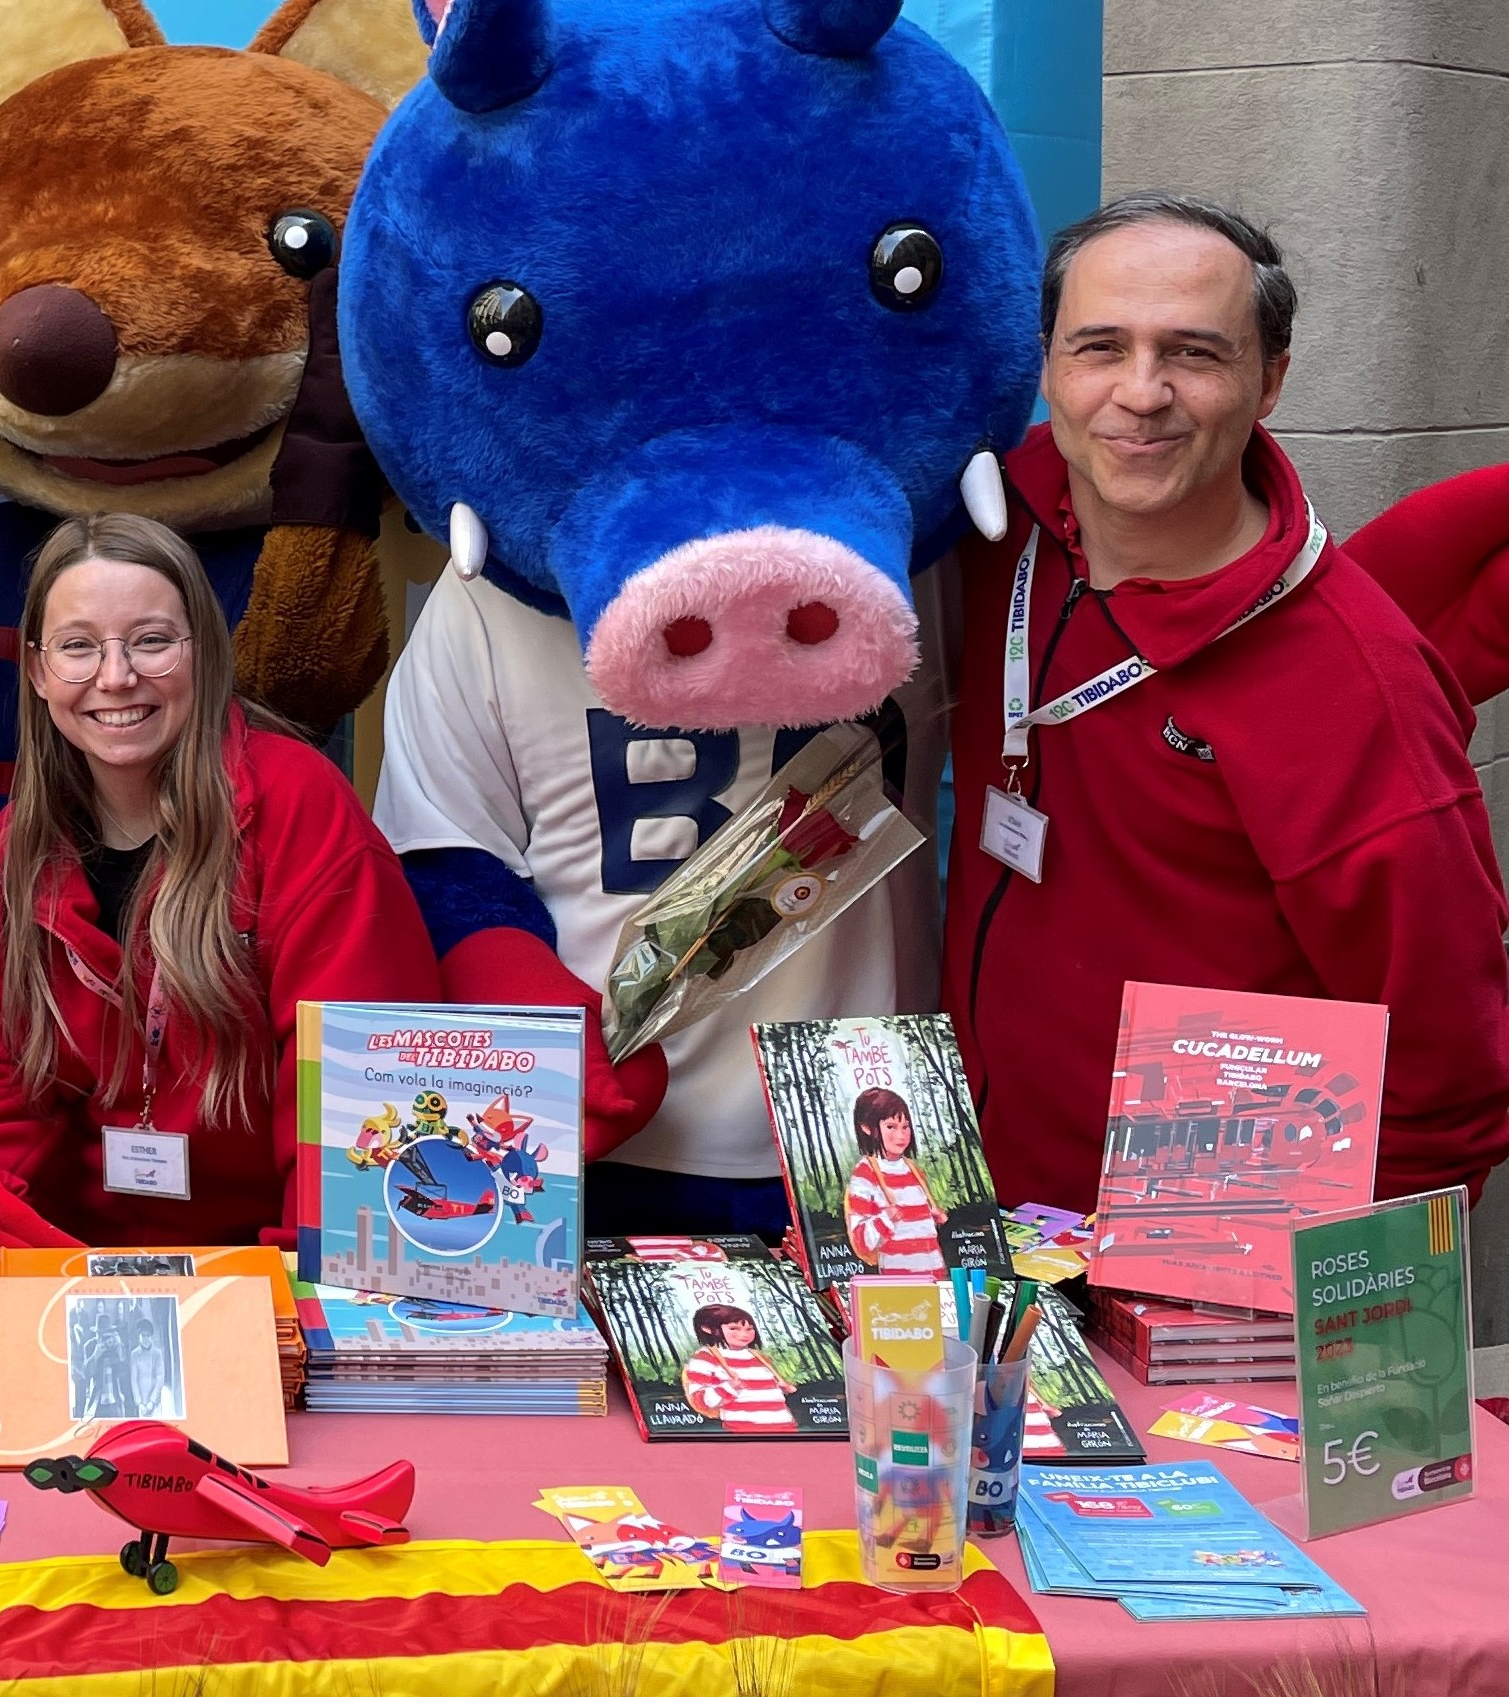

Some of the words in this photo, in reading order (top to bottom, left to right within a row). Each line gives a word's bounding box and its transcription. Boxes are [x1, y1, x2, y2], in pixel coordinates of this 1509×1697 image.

[1011, 552, 1032, 632] TIBIDABO!
[1162, 726, 1188, 751] BCN
[367, 1034, 393, 1050] LES
[393, 1030, 492, 1049] MASCOTES
[415, 1048, 535, 1073] TIBIDABO
[1172, 1039, 1322, 1068] CUCADELLUM
[1220, 1063, 1267, 1074] FUNICULAR
[364, 1067, 394, 1082] Com
[398, 1073, 427, 1087] vola
[431, 1075, 444, 1089] la
[448, 1077, 533, 1098] imaginació?
[501, 1186, 519, 1199] BO
[820, 1243, 852, 1260] ANNA
[958, 1245, 987, 1255] MARIA
[815, 1260, 864, 1279] LLAURADÓ
[960, 1255, 988, 1269] GIRÓN
[1311, 1250, 1370, 1280] ROSES
[1312, 1266, 1415, 1307] SOLIDÀRIES
[1314, 1310, 1358, 1336] SANT
[1362, 1297, 1413, 1325] JORDI
[871, 1327, 934, 1340] TIBIDABO
[1317, 1384, 1329, 1395] En
[1366, 1372, 1377, 1382] de
[655, 1402, 690, 1412] ANNA
[809, 1406, 841, 1415] MARIA
[650, 1414, 704, 1426] LLAURADÓ
[1323, 1430, 1381, 1485] 5€
[123, 1473, 193, 1493] TIBIDABO
[1027, 1477, 1115, 1490] FAMÍLIA
[1040, 1472, 1136, 1482] UNEIX-TE
[1159, 1470, 1189, 1479] LA
[975, 1479, 1004, 1498] BO
[730, 1548, 767, 1560] BO
